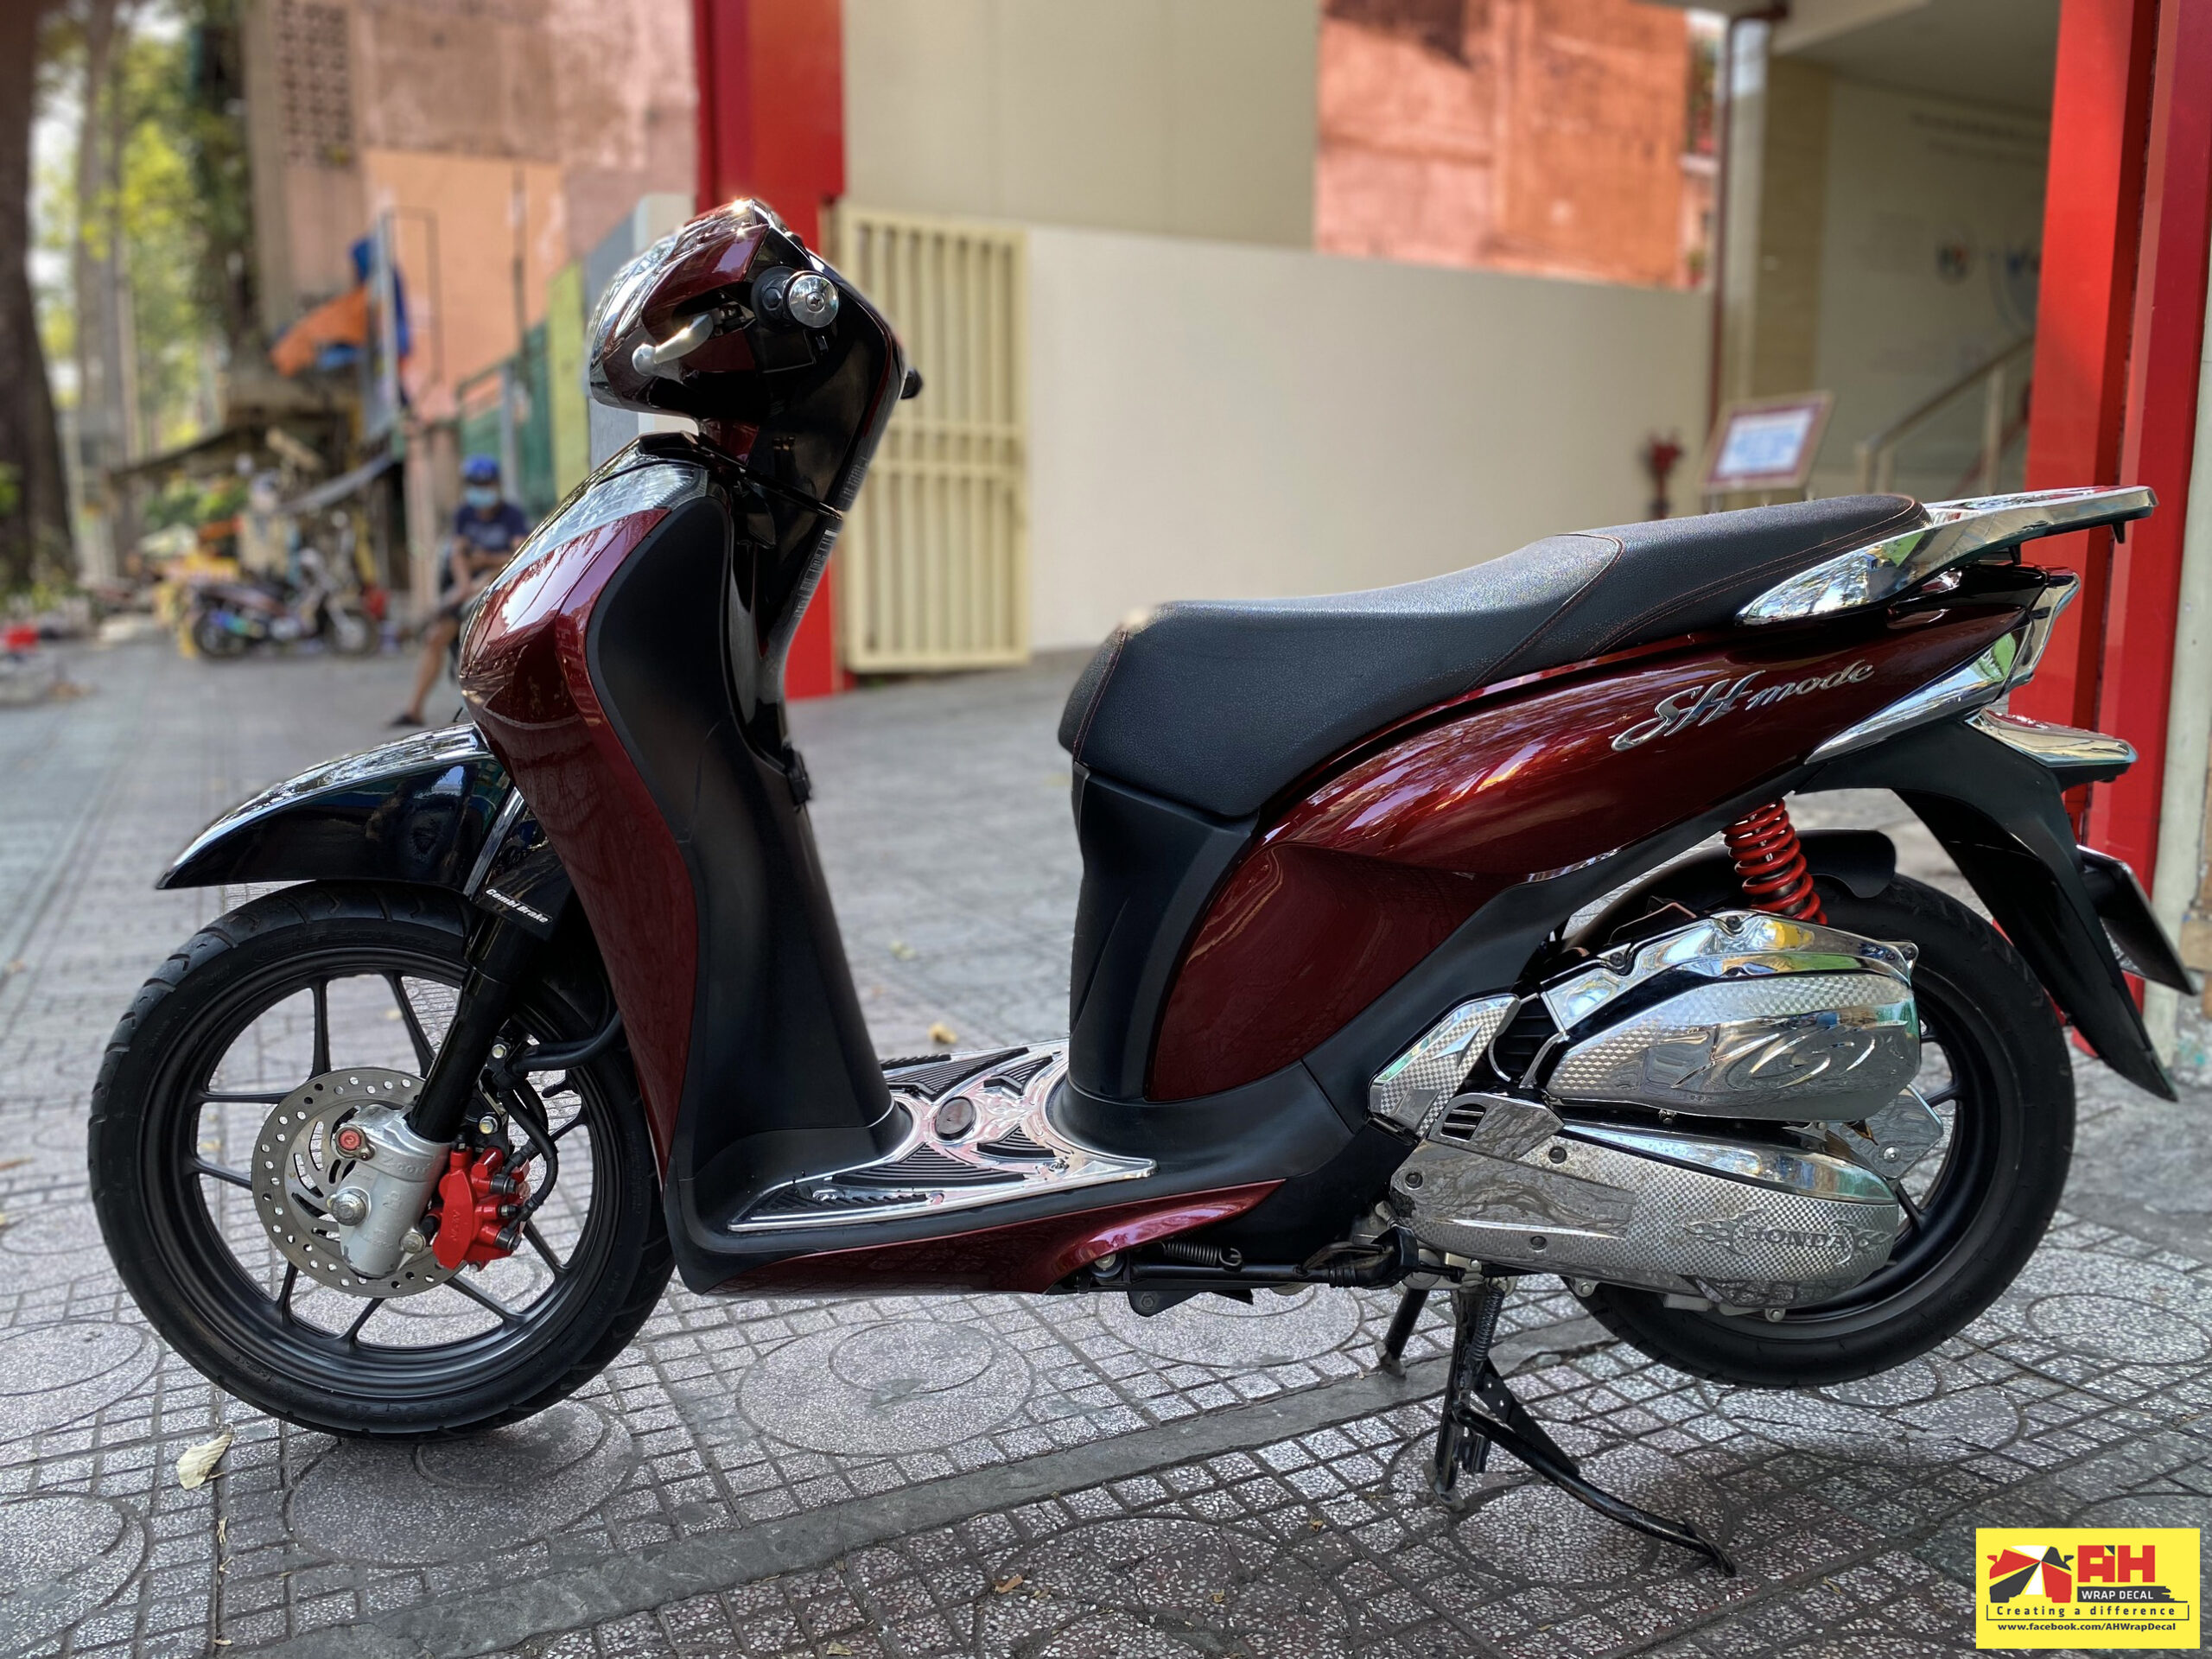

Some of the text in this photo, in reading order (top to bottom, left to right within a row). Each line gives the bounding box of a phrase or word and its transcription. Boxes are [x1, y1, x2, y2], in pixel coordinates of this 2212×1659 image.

[1608, 659, 1874, 752] SH mode
[486, 888, 549, 923] Combi Brake
[1743, 1224, 1846, 1249] HONDA
